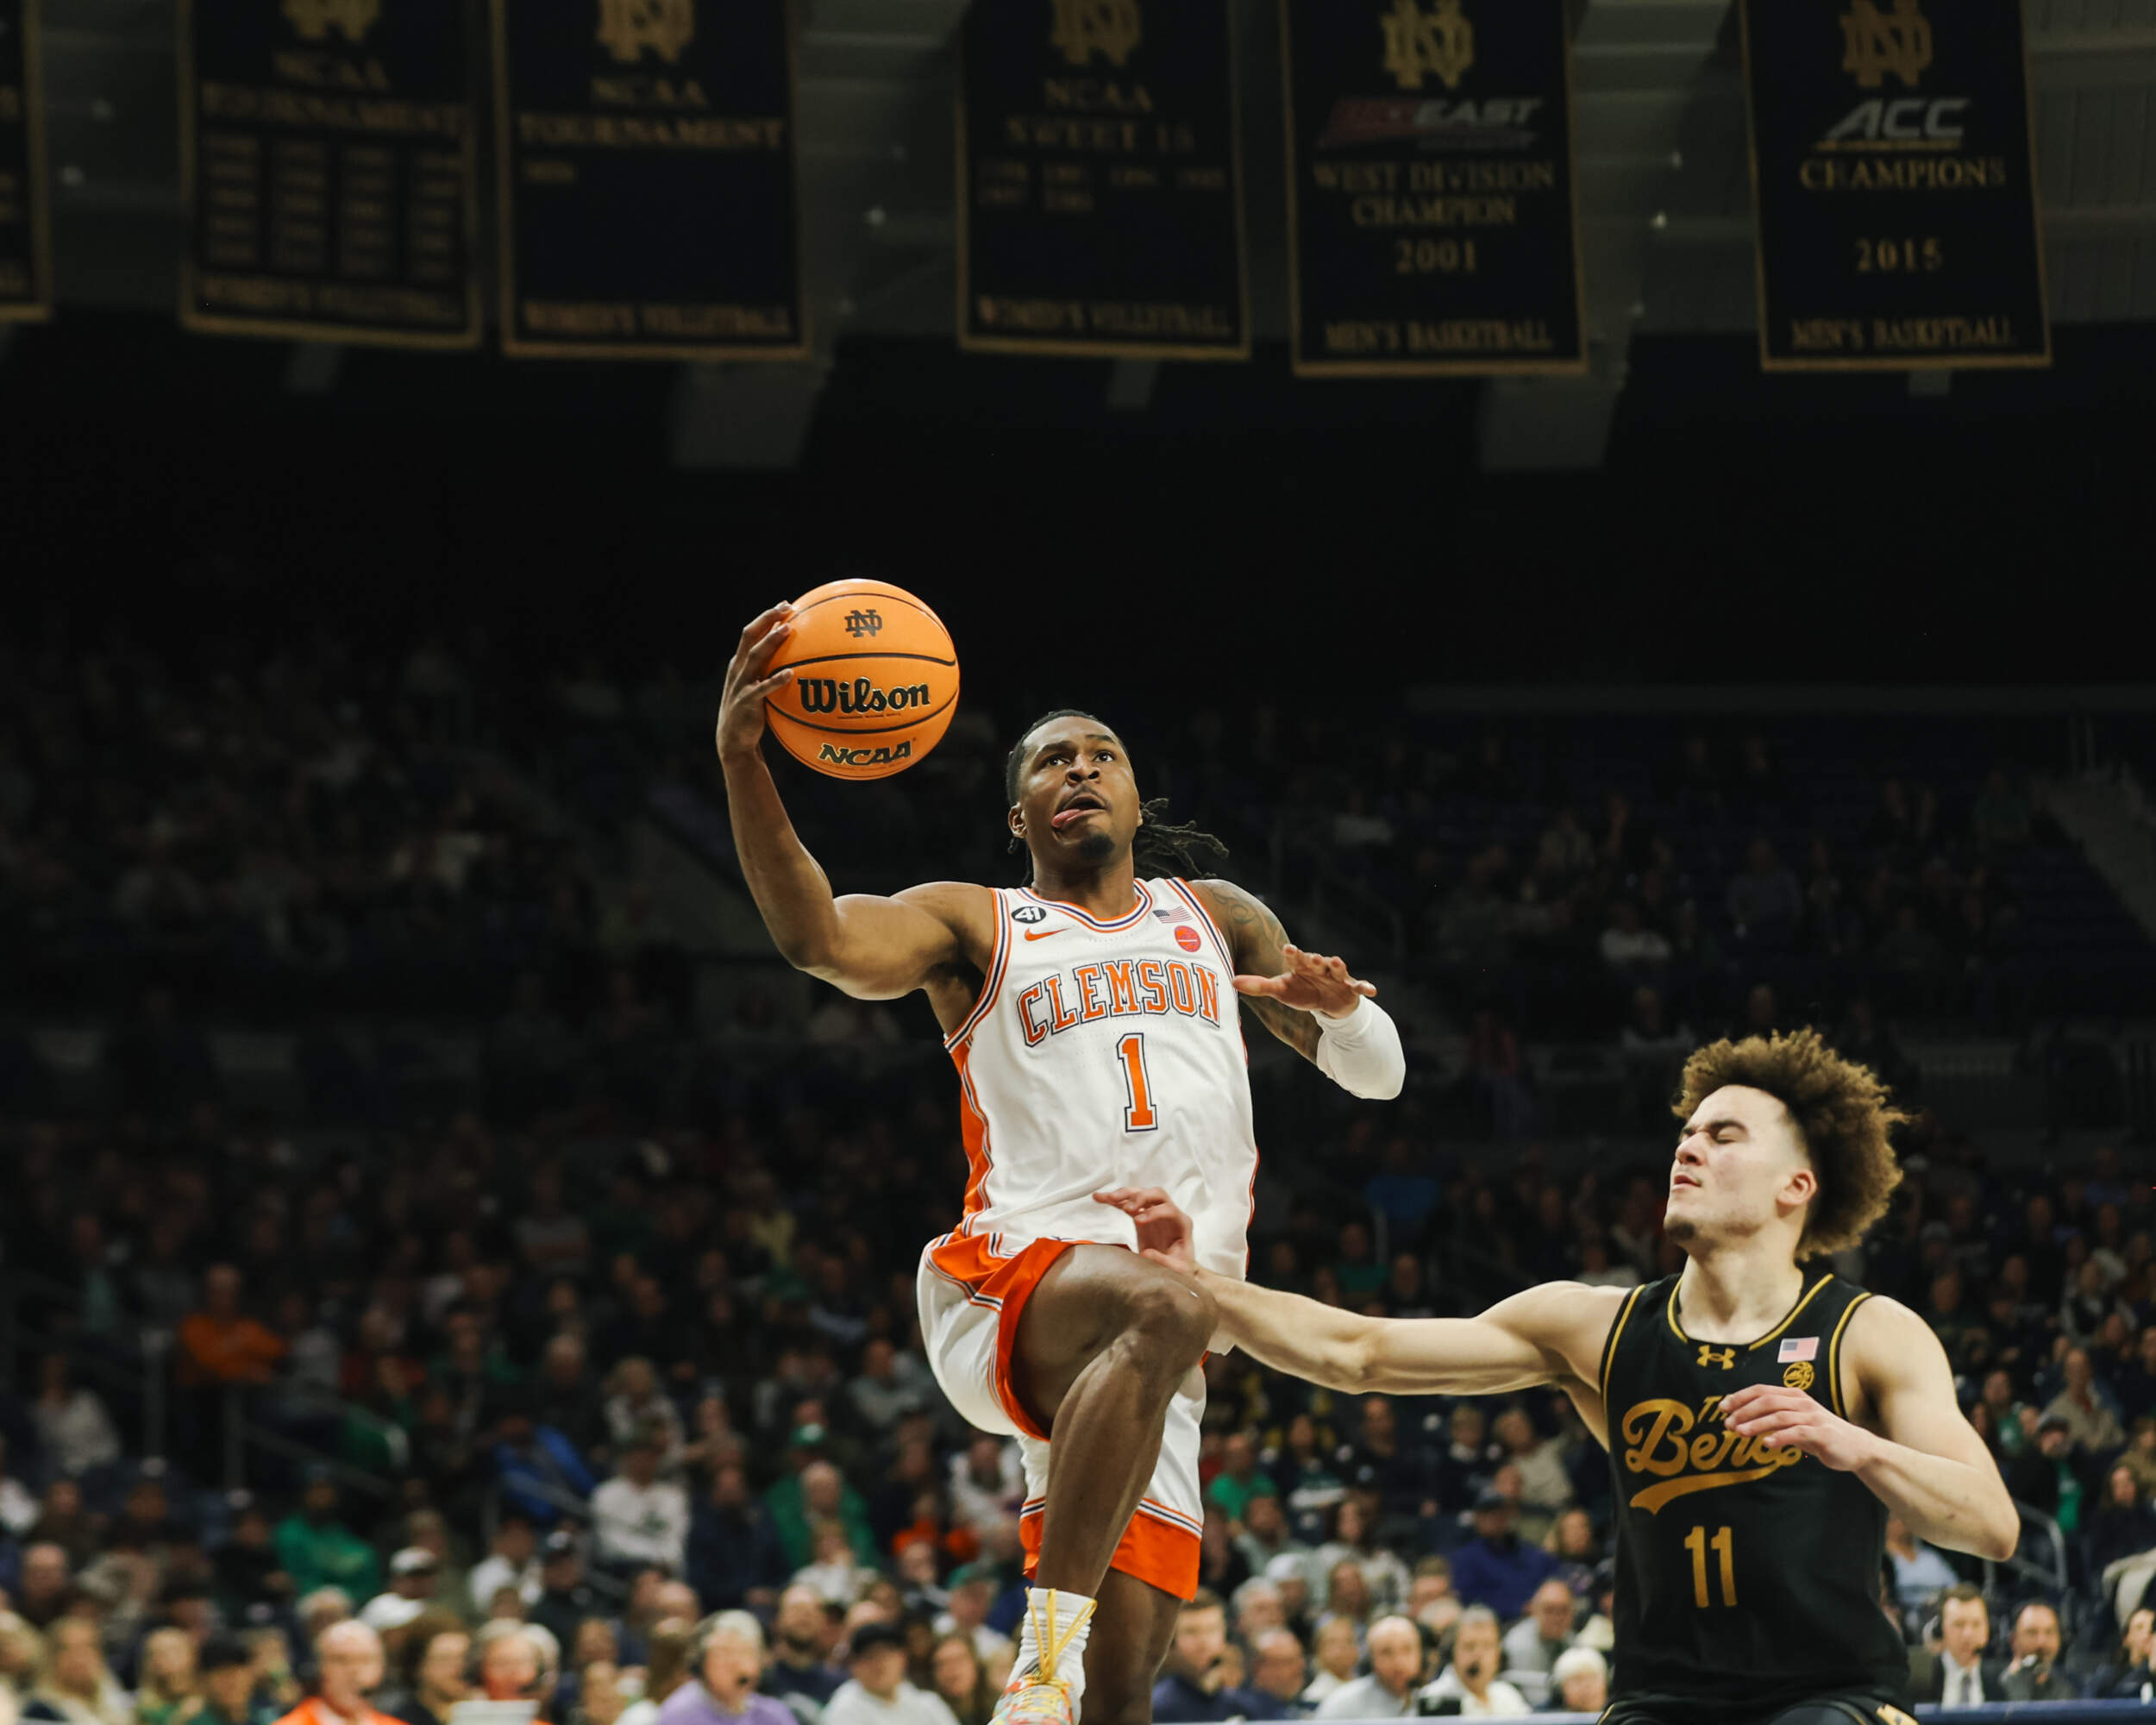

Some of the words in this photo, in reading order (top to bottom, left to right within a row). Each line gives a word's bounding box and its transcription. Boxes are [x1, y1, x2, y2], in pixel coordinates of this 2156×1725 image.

[1824, 97, 1971, 141] ACC
[1313, 160, 1397, 193] WEST
[1409, 160, 1555, 193] DIVISION
[1351, 195, 1517, 228] CHAMPION
[1394, 238, 1476, 275] 2001
[1855, 237, 1944, 273] 2015
[797, 676, 930, 713] Wilson
[818, 740, 912, 766] NCAA
[1014, 906, 1042, 921] 41
[1017, 959, 1220, 1048] CLEMSON
[1117, 1032, 1157, 1132] 1
[1683, 1524, 1739, 1609] 11
